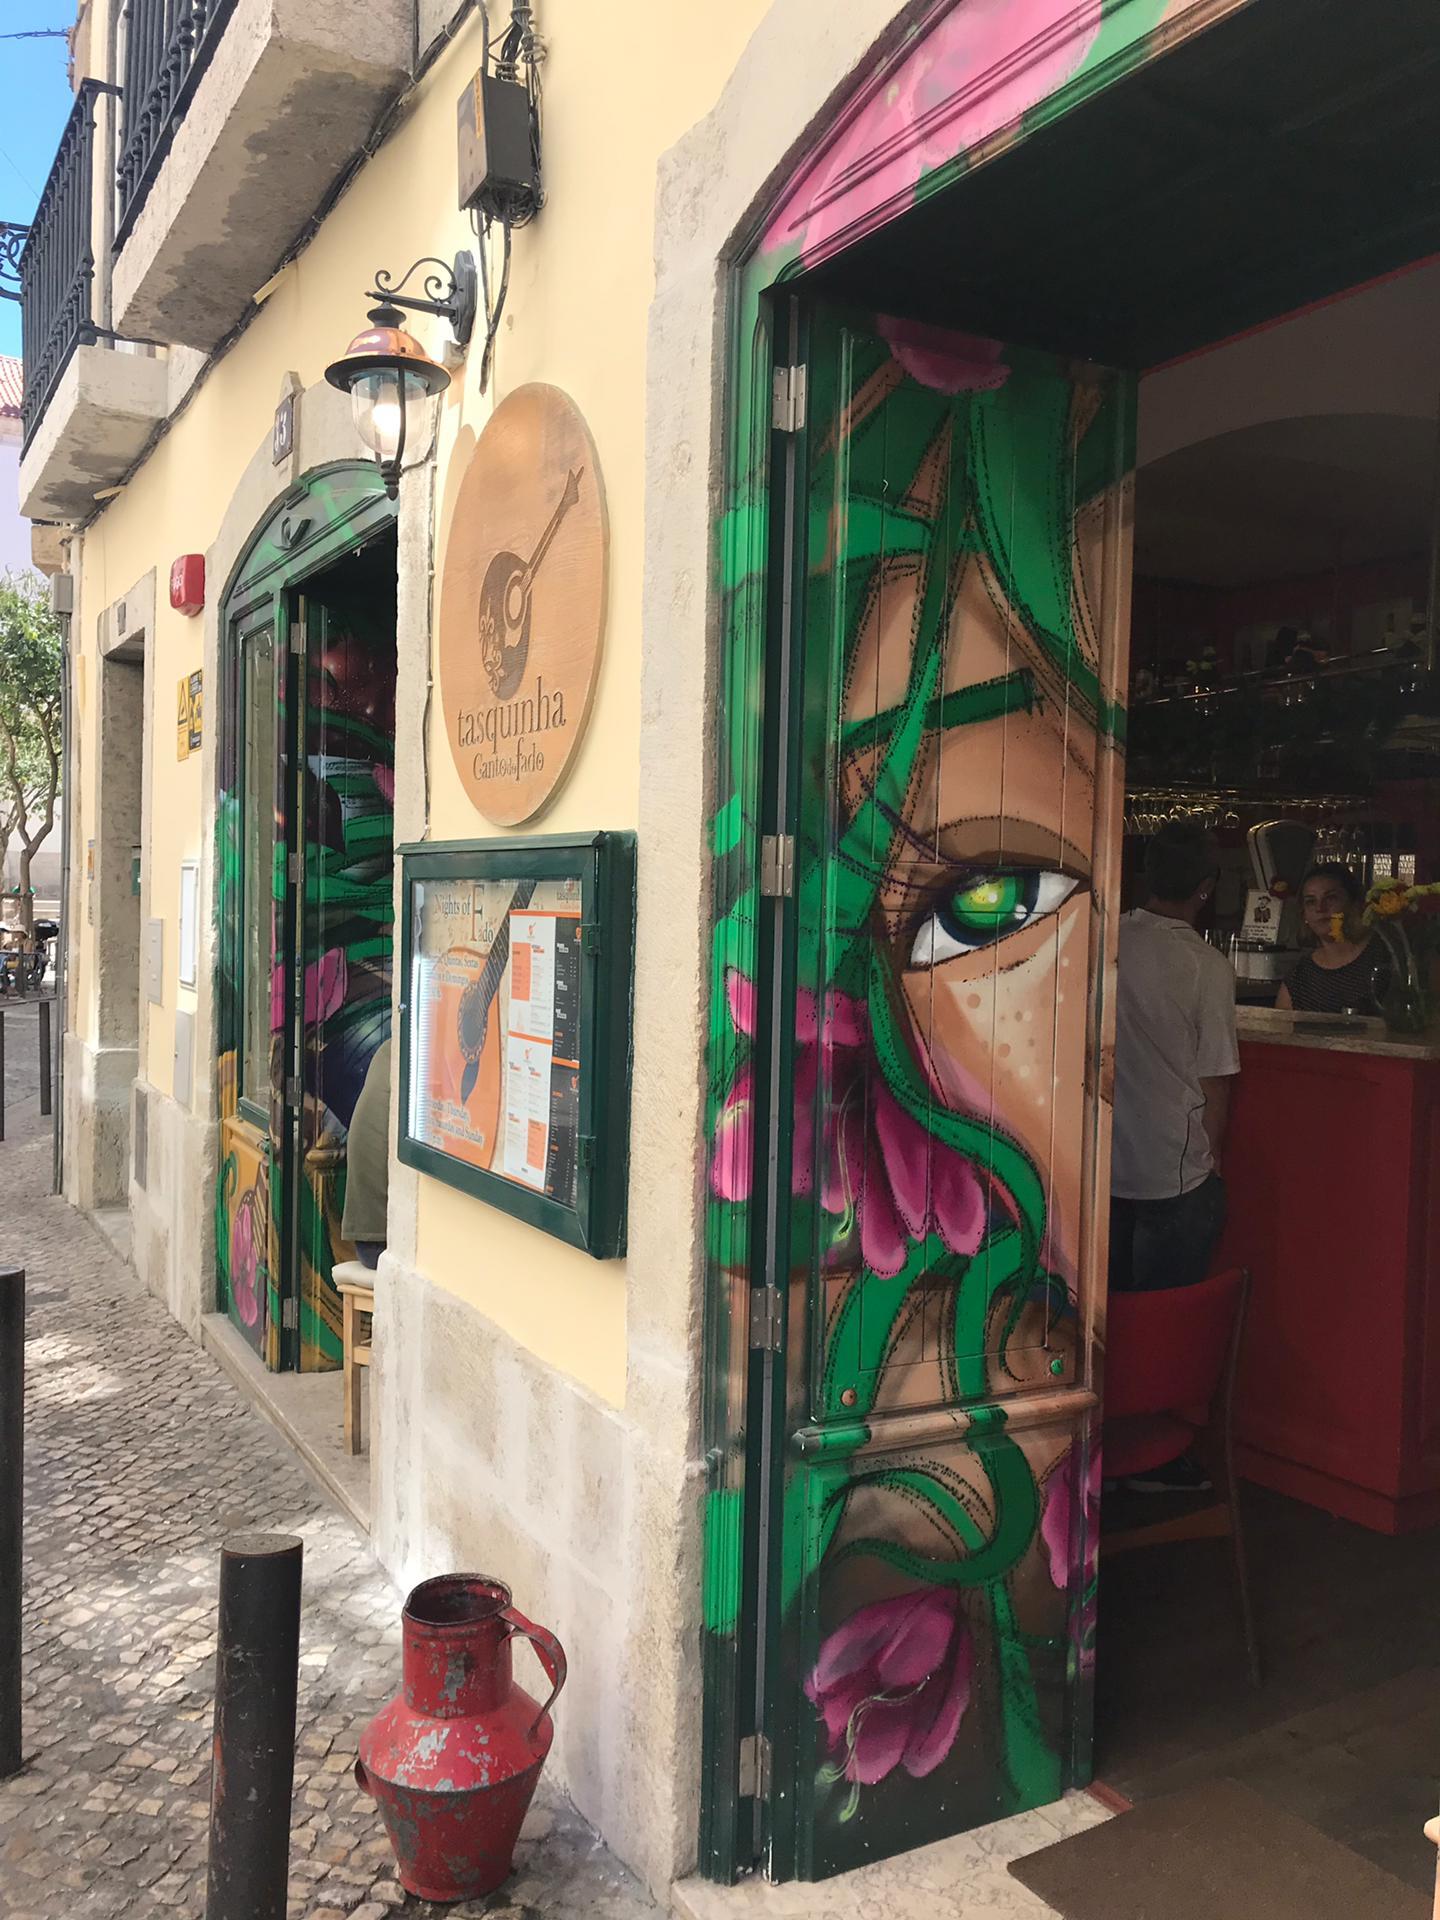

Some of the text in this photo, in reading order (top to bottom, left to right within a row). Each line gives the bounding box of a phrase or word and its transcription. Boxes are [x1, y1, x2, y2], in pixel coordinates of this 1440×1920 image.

[457, 676, 567, 754] tasquinha
[473, 753, 507, 780] Canto
[516, 737, 545, 781] fado
[433, 894, 461, 919] Nights
[461, 894, 472, 916] of
